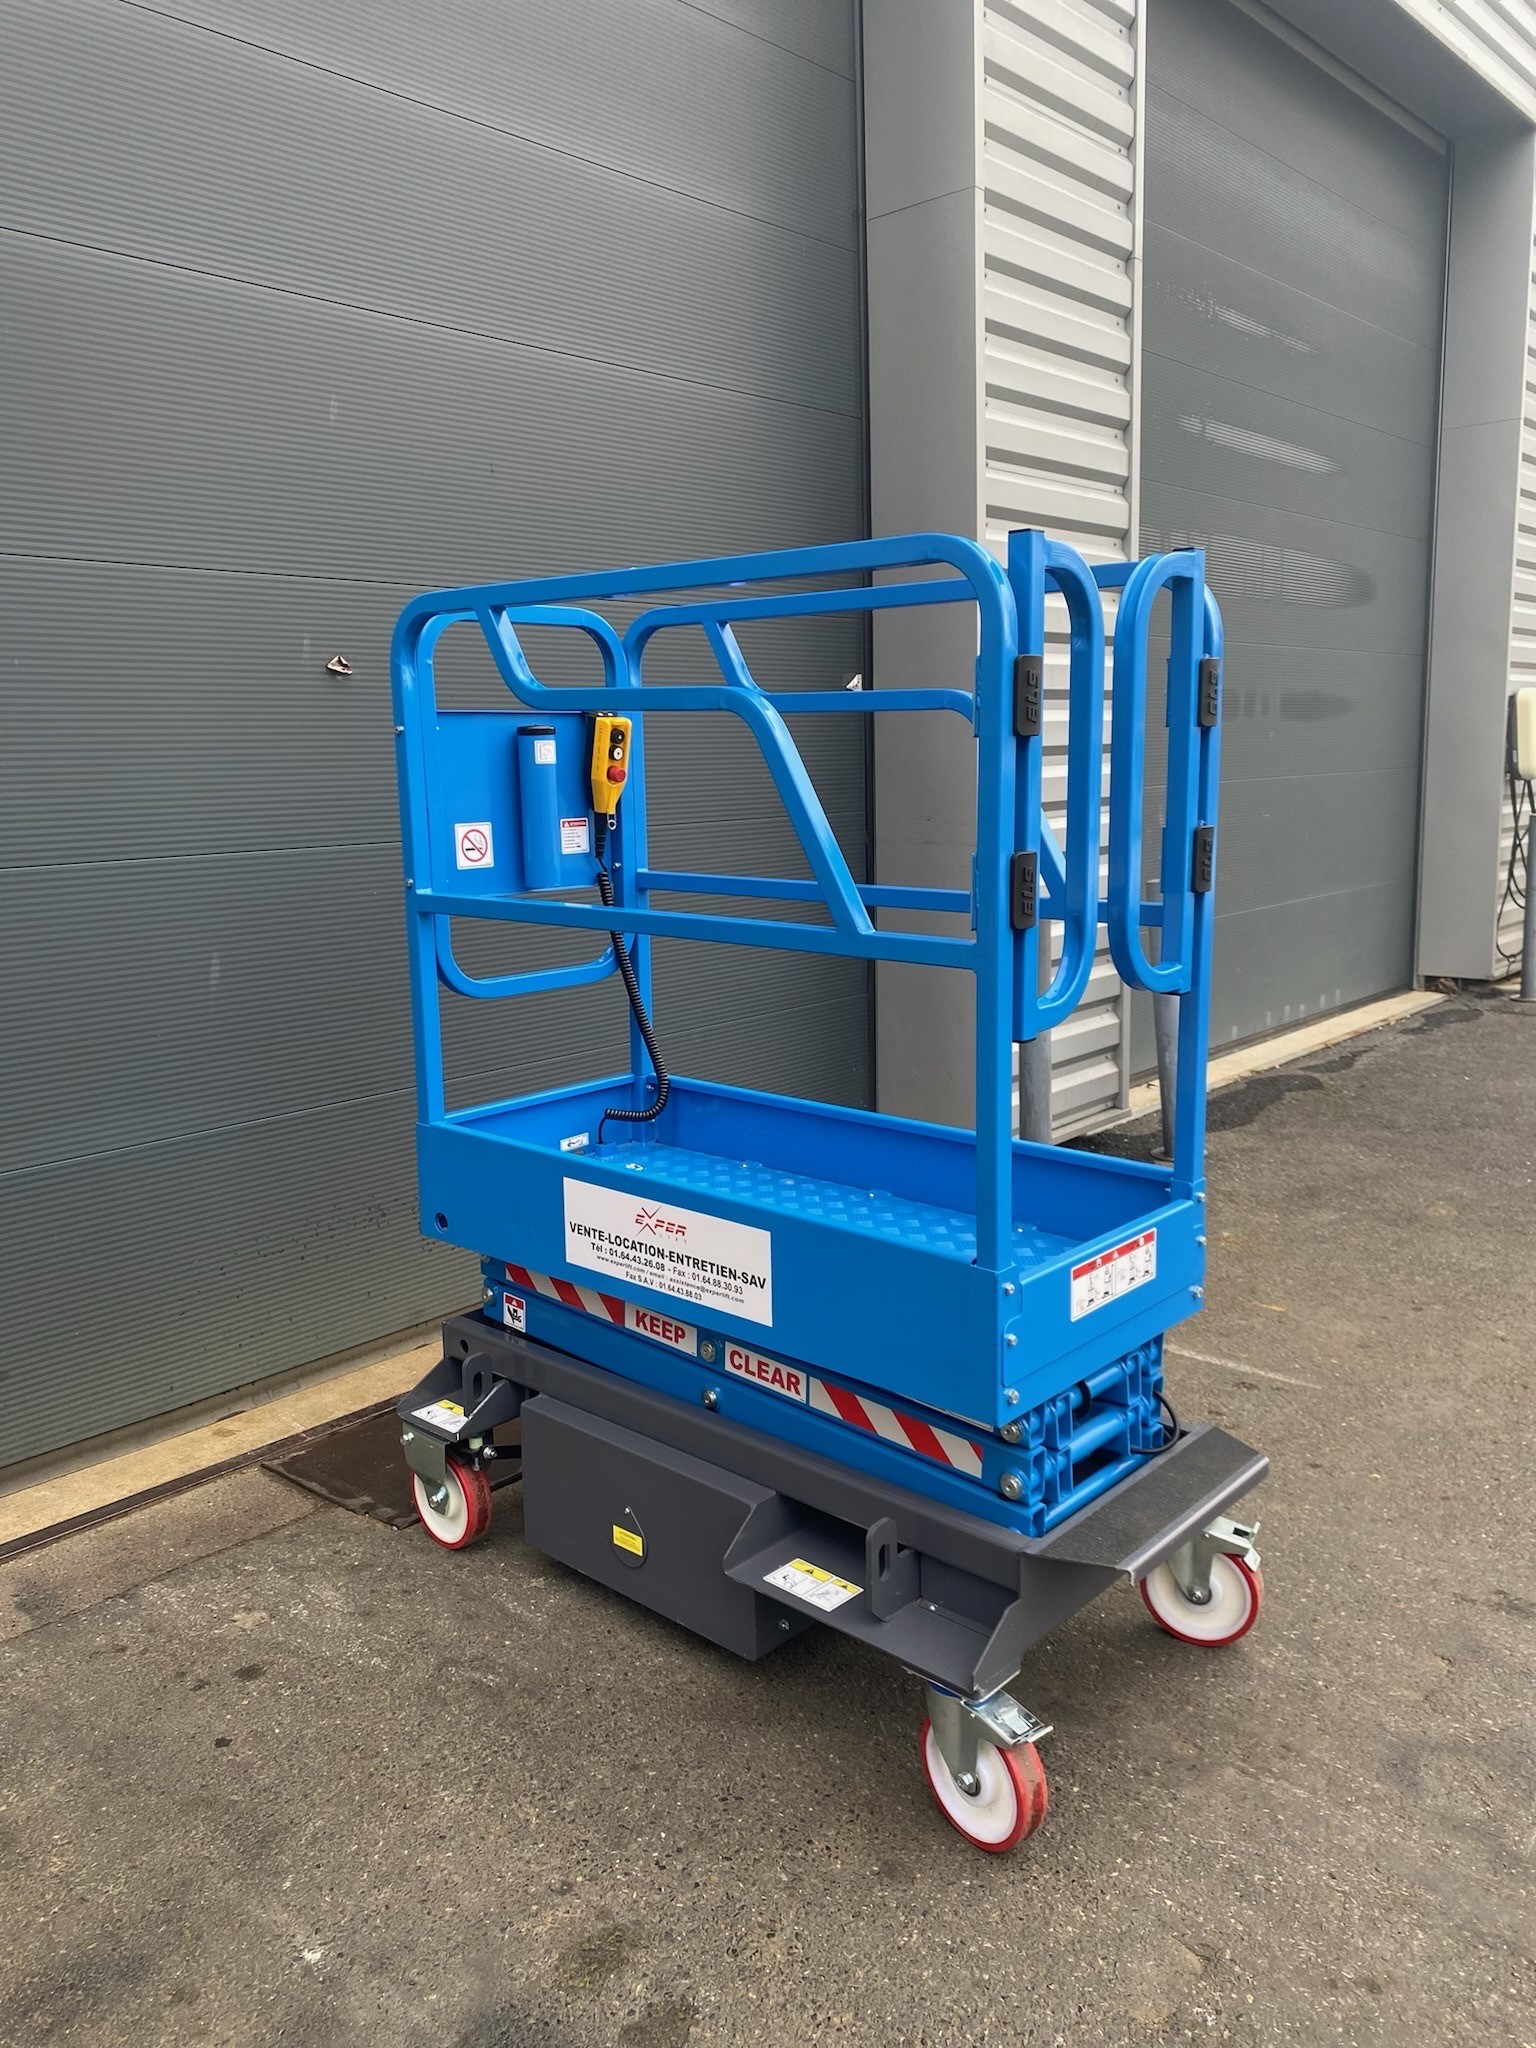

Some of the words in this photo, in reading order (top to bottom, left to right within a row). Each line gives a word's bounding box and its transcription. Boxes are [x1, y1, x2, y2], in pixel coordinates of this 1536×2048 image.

[634, 1205, 687, 1237] EXPER
[569, 1221, 767, 1290] VENTE-LOCATION-ENTRETIEN-SAV
[596, 1255, 646, 1274] www.experlift.com
[649, 1271, 665, 1280] email
[669, 1277, 745, 1304] assistance@experlift.com
[609, 1248, 665, 1272] 01.64.43.26.08
[673, 1266, 686, 1278] Fax
[691, 1272, 743, 1295] 01.64.88.30.93
[625, 1271, 637, 1281] Fax
[635, 1309, 686, 1344] KEEP
[729, 1350, 802, 1396] CLEAR
